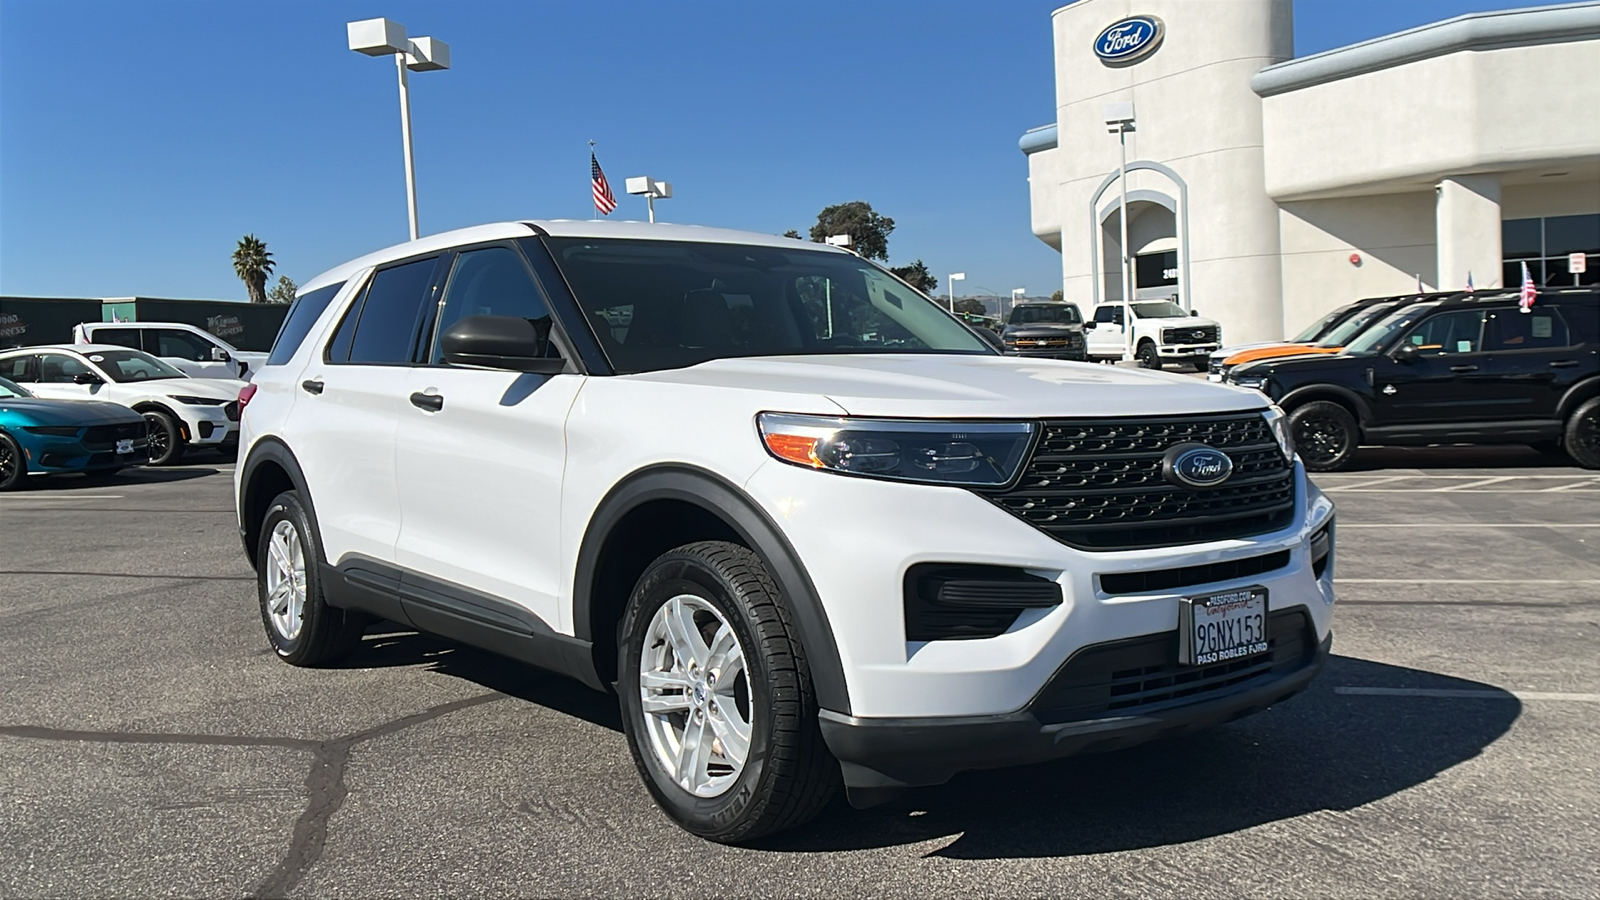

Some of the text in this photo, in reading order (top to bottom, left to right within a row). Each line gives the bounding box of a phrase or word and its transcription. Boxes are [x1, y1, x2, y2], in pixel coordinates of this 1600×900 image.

[1104, 24, 1142, 53] Ford
[1191, 456, 1222, 477] Ford
[1197, 613, 1263, 655] 9GNX153
[1197, 642, 1268, 665] PASO ROBLES FORD
